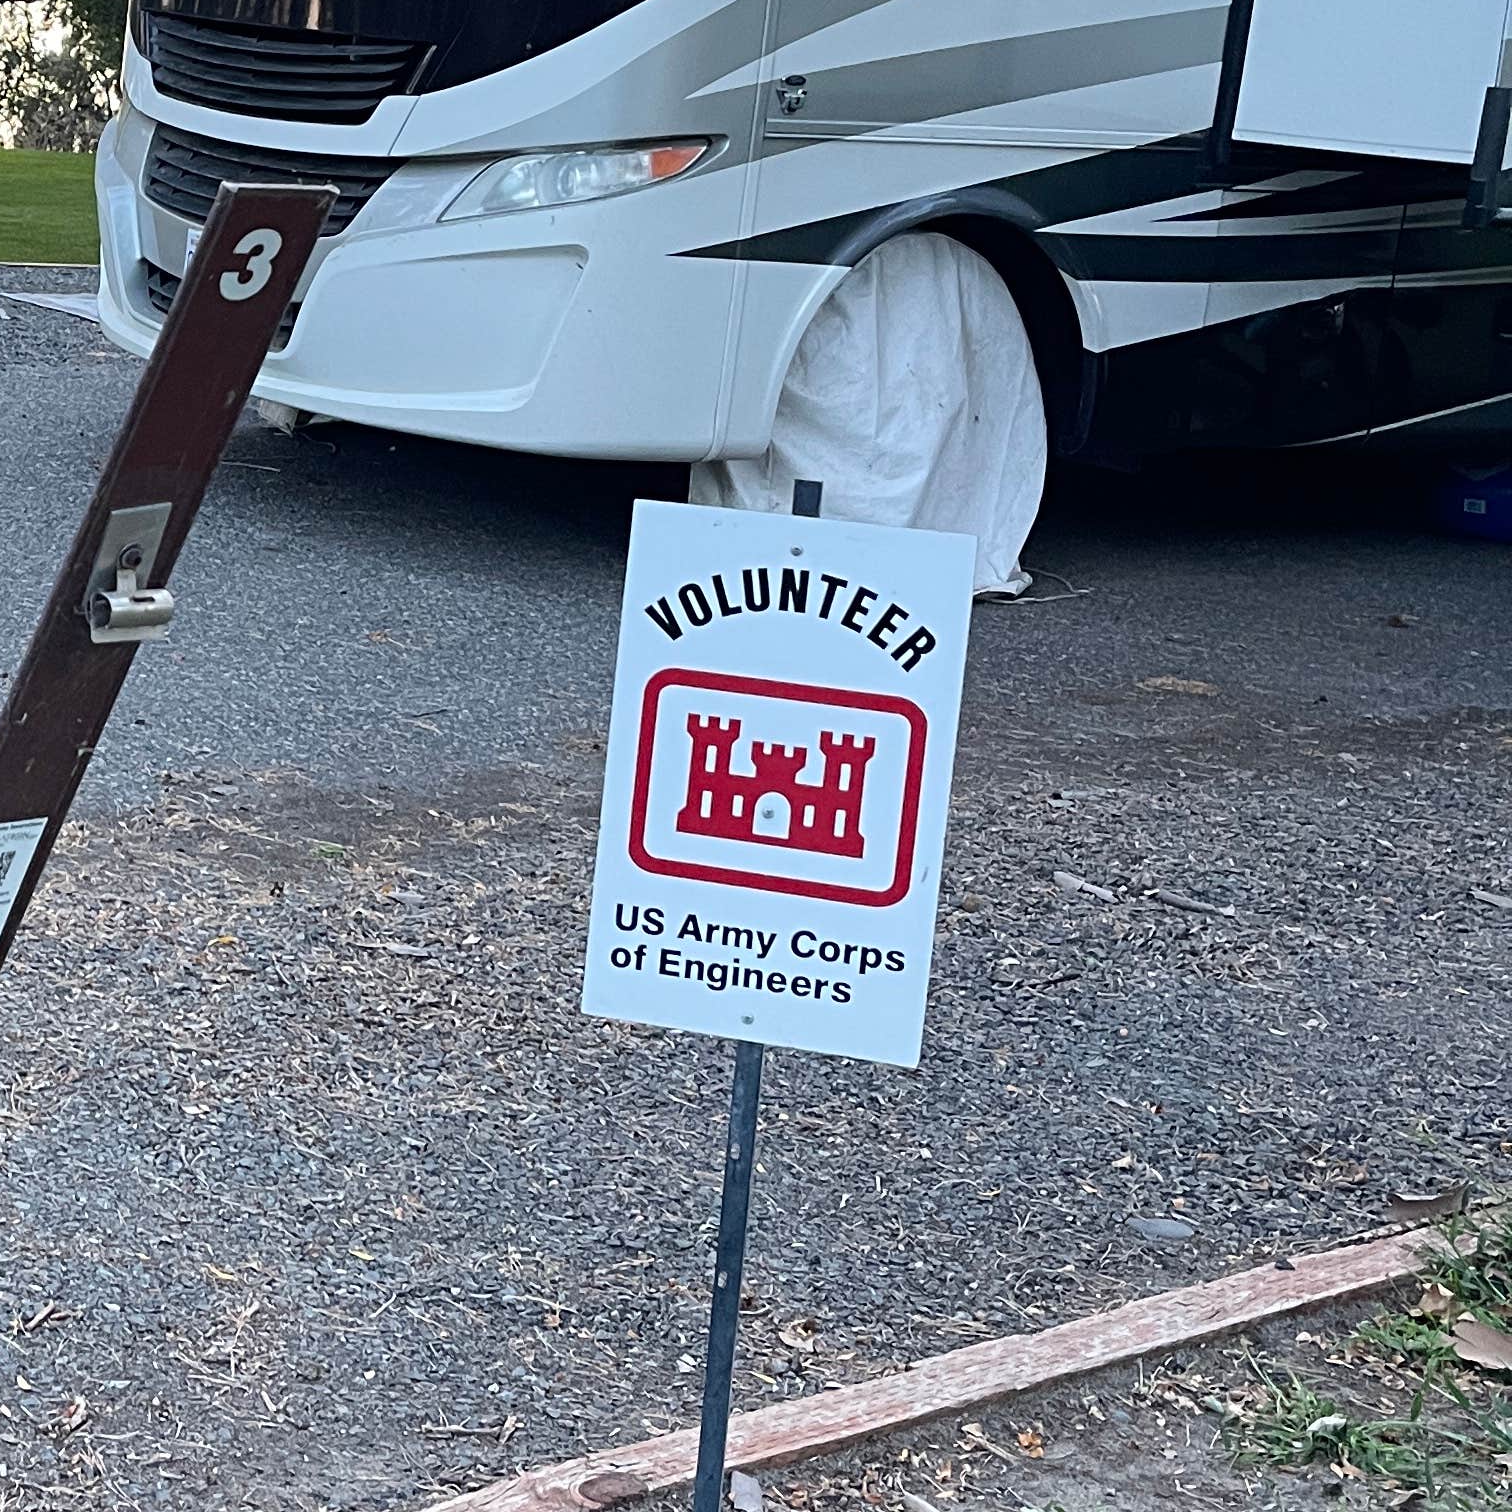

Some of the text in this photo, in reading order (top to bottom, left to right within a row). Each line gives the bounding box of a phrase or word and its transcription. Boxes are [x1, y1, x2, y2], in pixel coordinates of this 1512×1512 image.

[220, 229, 283, 301] 3
[644, 567, 937, 673] VOLUNTEER
[614, 903, 906, 973] US Army Corps
[610, 944, 853, 1004] of Engineers
